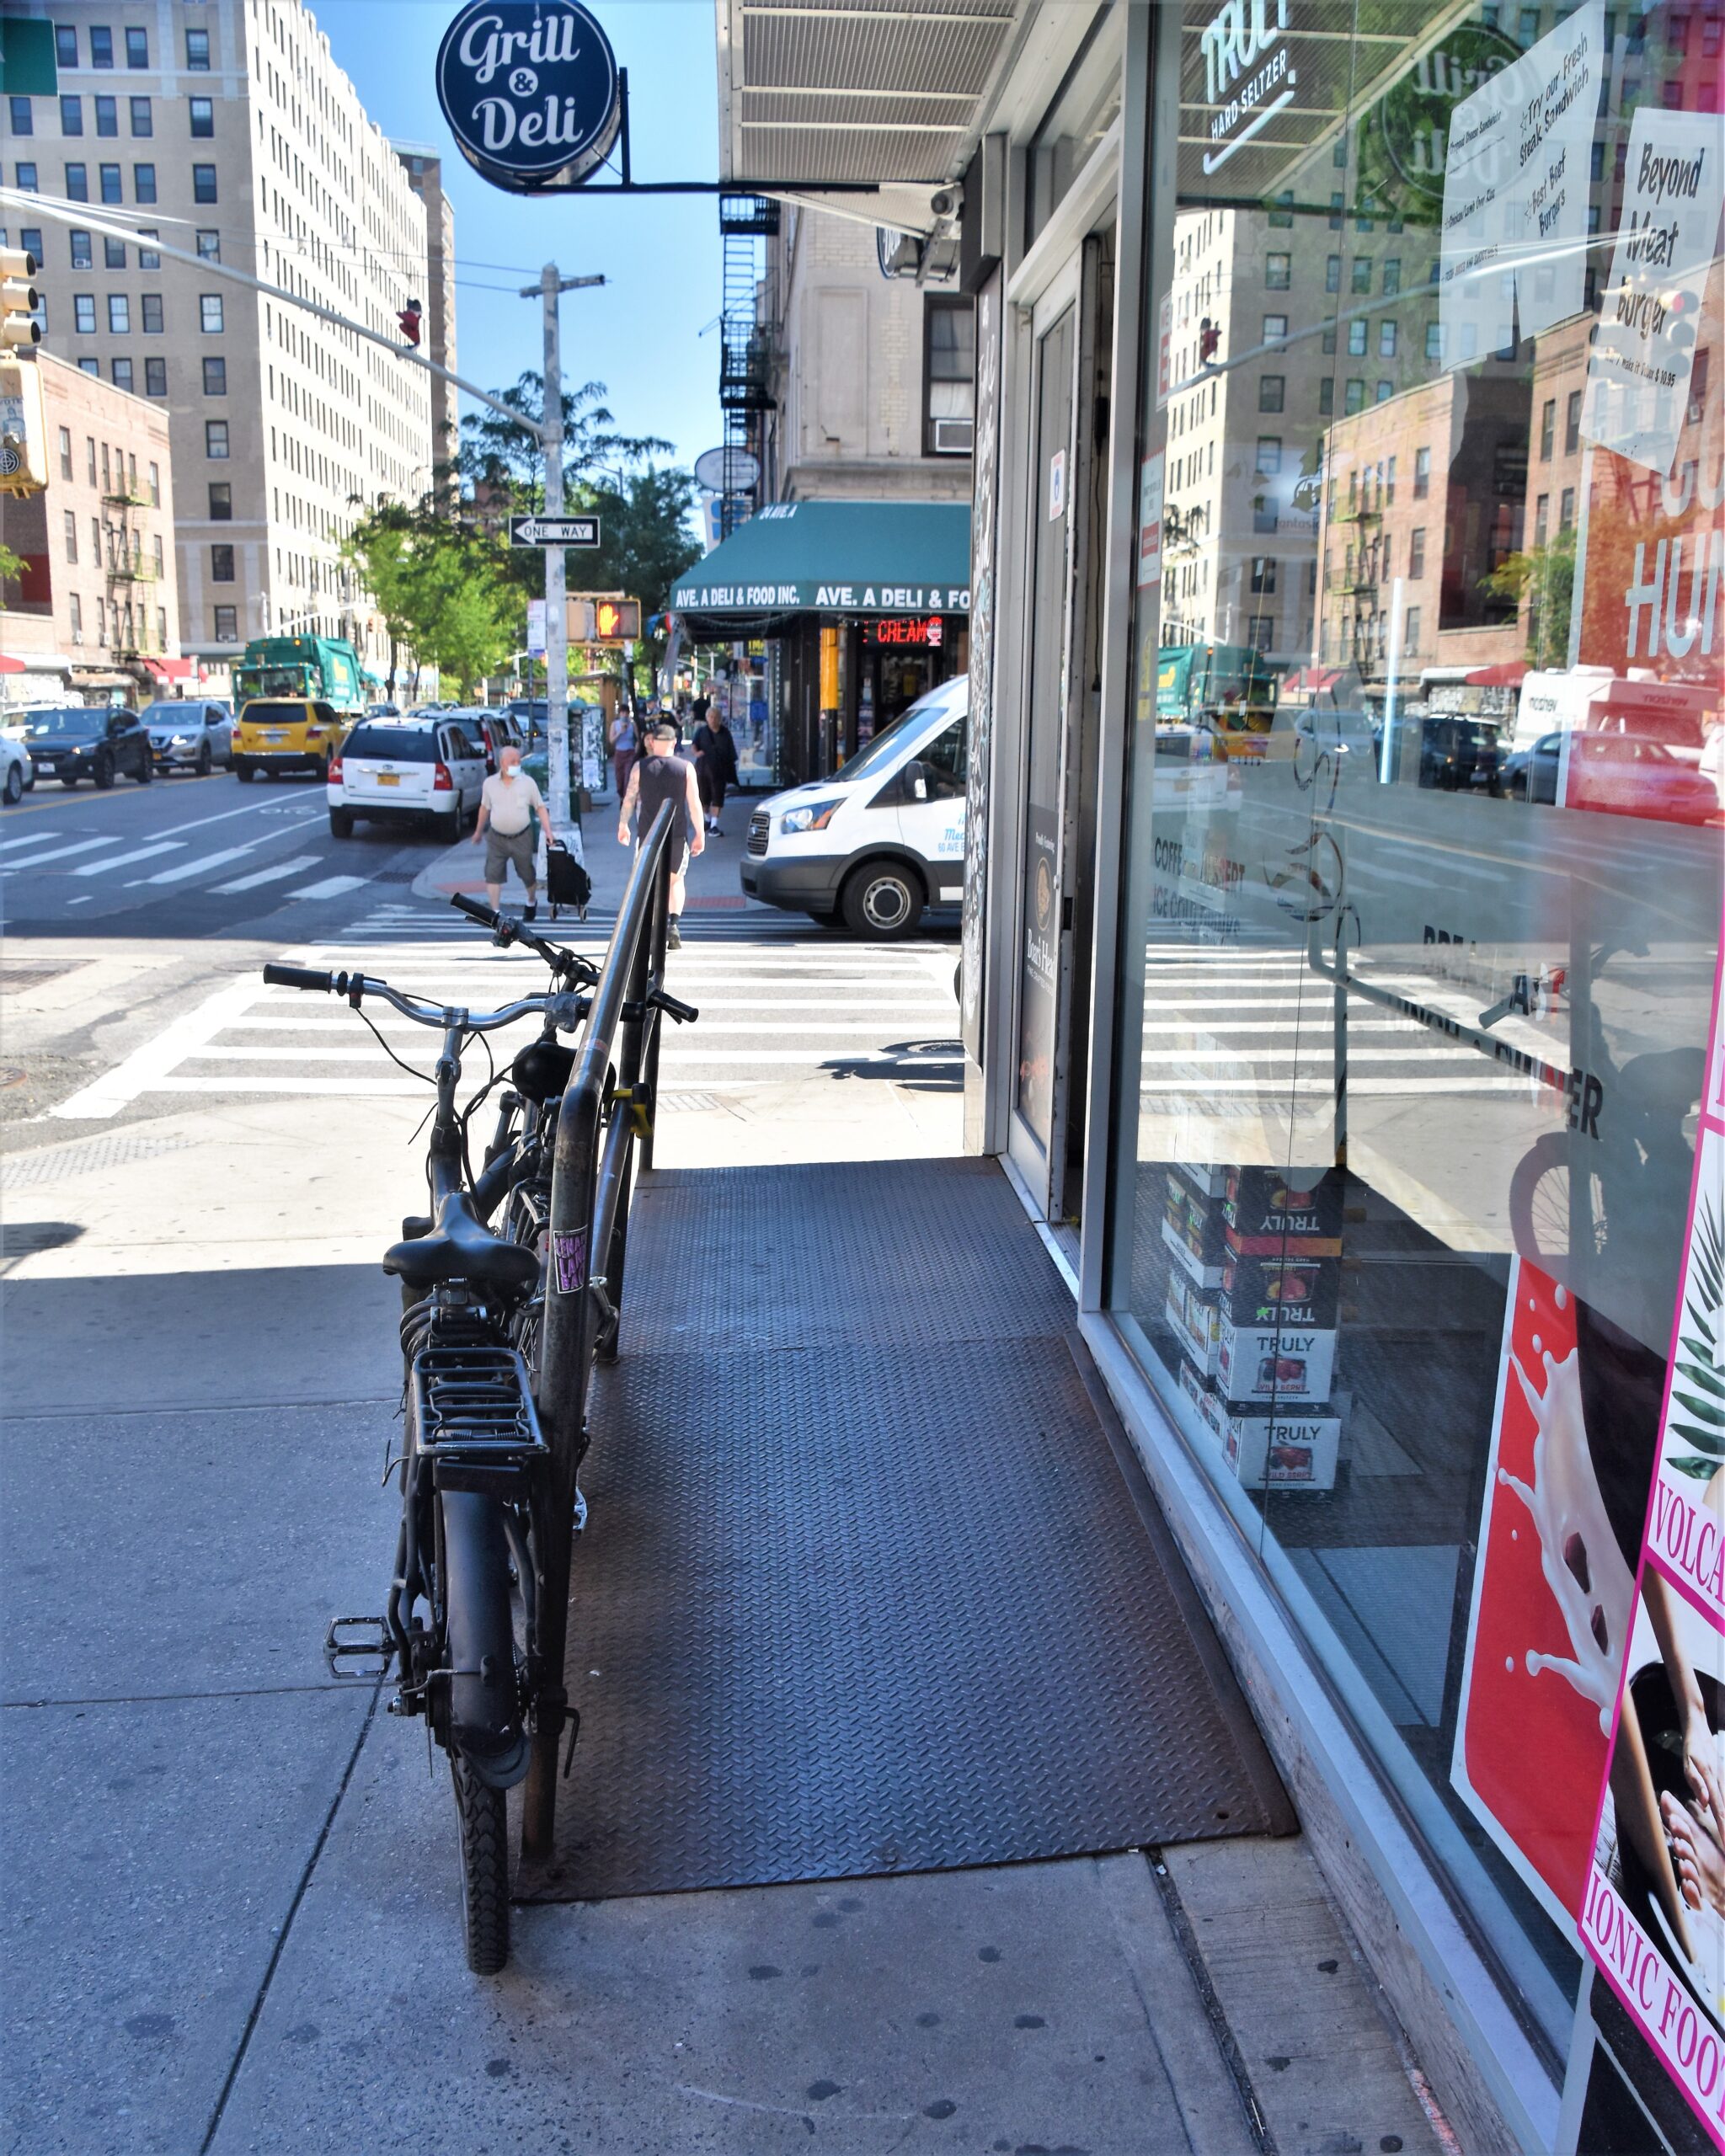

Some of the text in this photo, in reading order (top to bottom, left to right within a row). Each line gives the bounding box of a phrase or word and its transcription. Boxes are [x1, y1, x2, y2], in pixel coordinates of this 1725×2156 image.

[459, 14, 580, 83] Grill
[1211, 48, 1286, 143] HARD SELTZER
[1527, 32, 1588, 125] Try our Fresh
[472, 95, 583, 151] Deli
[1519, 63, 1589, 168] Steak Sandwich
[1531, 147, 1567, 215] Best Beef
[1637, 141, 1705, 205] Beyond
[1626, 210, 1680, 268] Meat
[524, 526, 587, 537] ONE WAY
[676, 584, 800, 607] AVE. A DELI & FOOD INC.
[815, 586, 857, 606] AVE.
[862, 588, 877, 606] A
[881, 588, 922, 608] DELI
[928, 590, 943, 609] &
[878, 618, 927, 643] CREAM
[1260, 1215, 1320, 1231] TRULY
[1256, 1306, 1315, 1322] TRULY
[1257, 1337, 1315, 1352] TRULY
[1264, 1426, 1321, 1441] TRULY
[1656, 1479, 1725, 1607] VOLCA
[1586, 1870, 1659, 2010] IONIC
